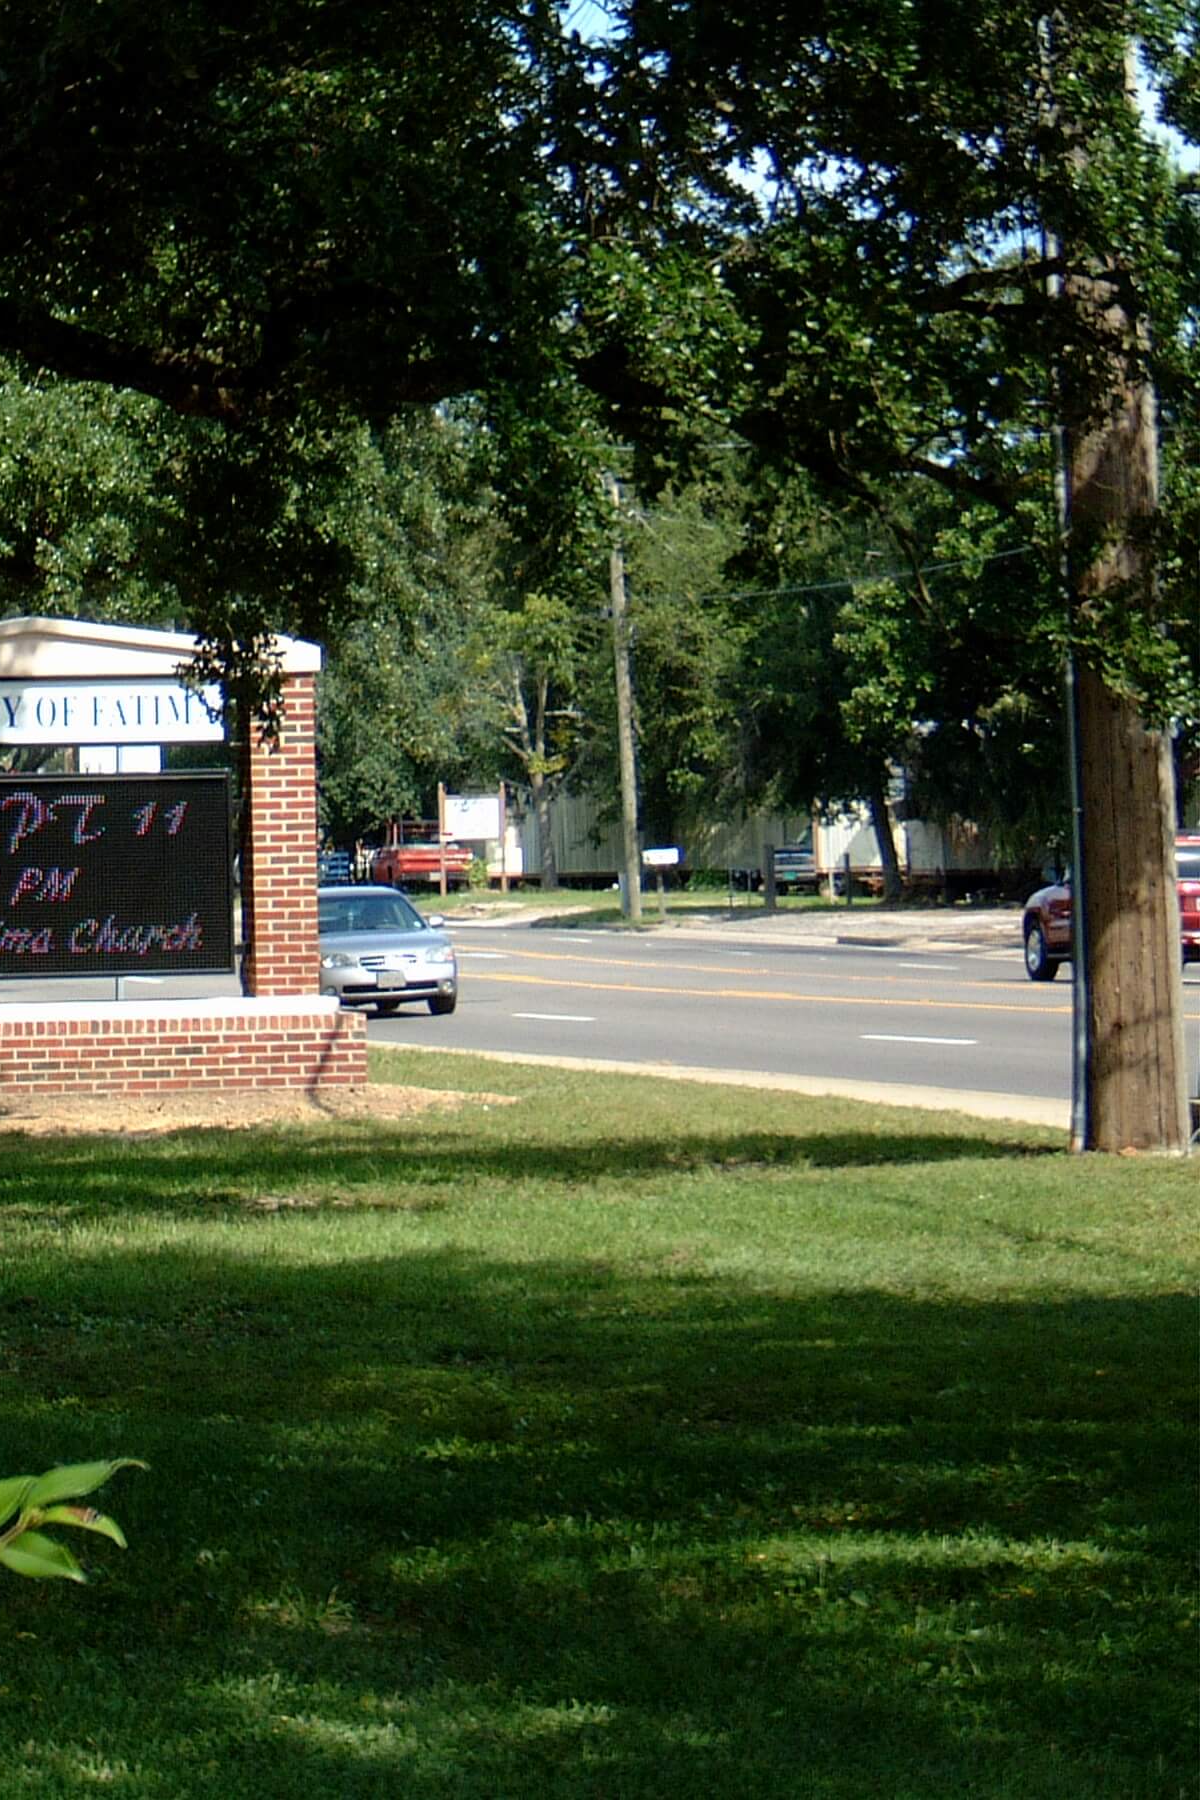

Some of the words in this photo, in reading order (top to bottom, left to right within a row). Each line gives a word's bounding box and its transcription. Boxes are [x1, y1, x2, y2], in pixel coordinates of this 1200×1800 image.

[36, 696, 78, 728] OF
[92, 694, 216, 727] FATIM
[133, 801, 188, 837] 11
[9, 867, 81, 906] PM
[69, 912, 203, 956] Church
